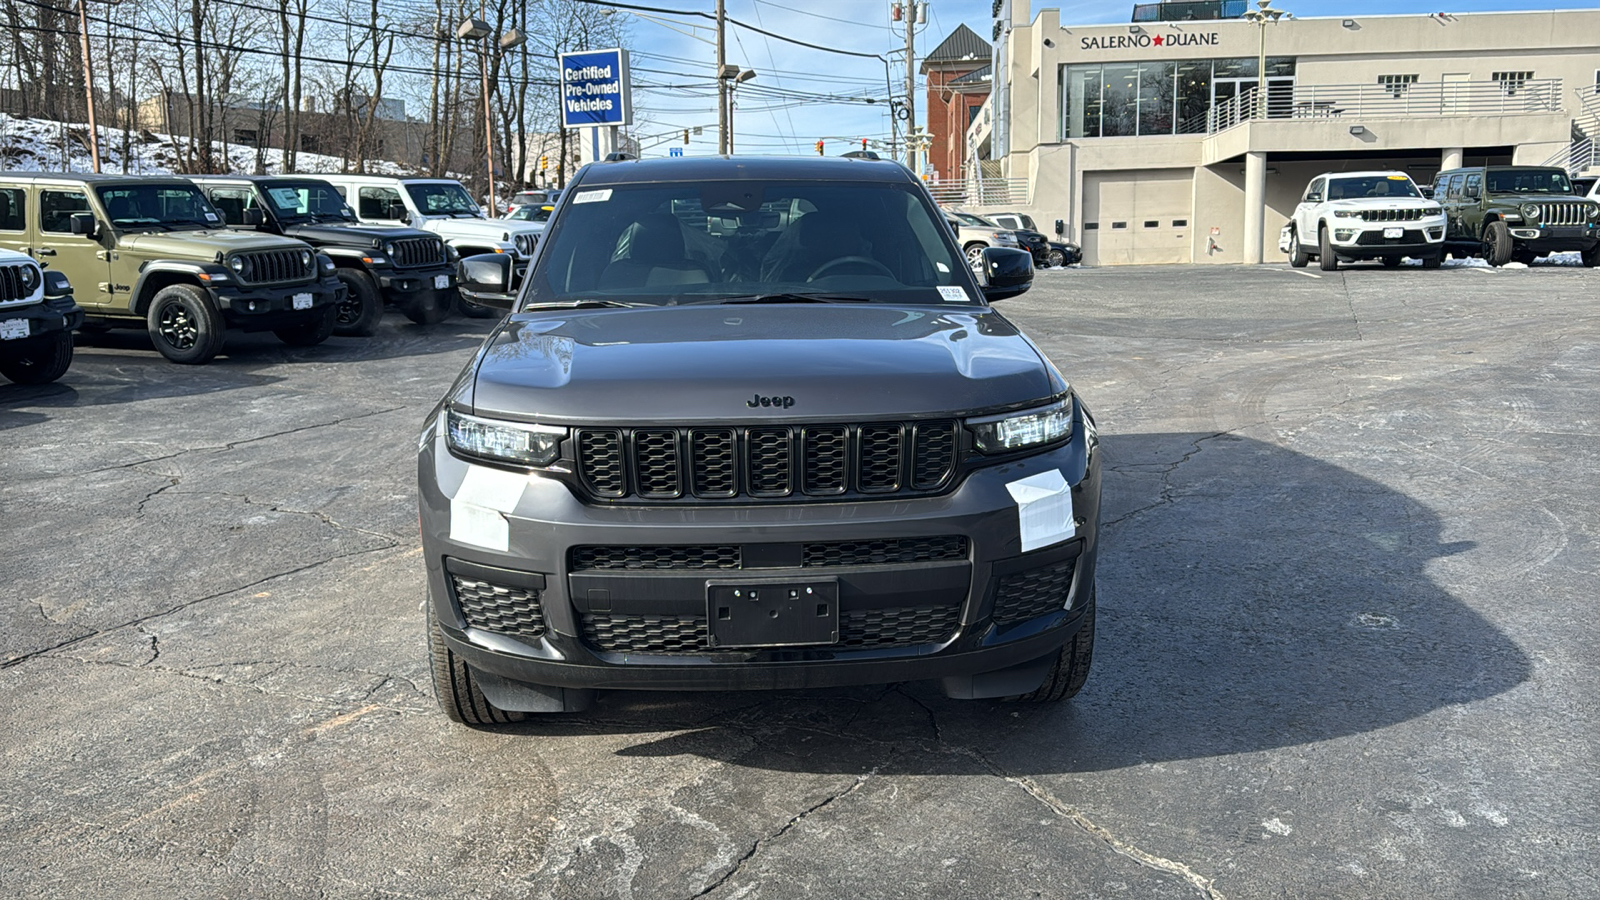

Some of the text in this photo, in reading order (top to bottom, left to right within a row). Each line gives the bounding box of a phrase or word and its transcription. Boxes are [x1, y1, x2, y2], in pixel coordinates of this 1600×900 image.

[1081, 32, 1219, 50] SALERNO DUANE
[565, 64, 611, 80] Certified
[566, 80, 619, 97] Pre-Owned
[567, 97, 613, 113] Vehicles
[114, 283, 130, 291] Jeep
[746, 393, 796, 410] Jeep
